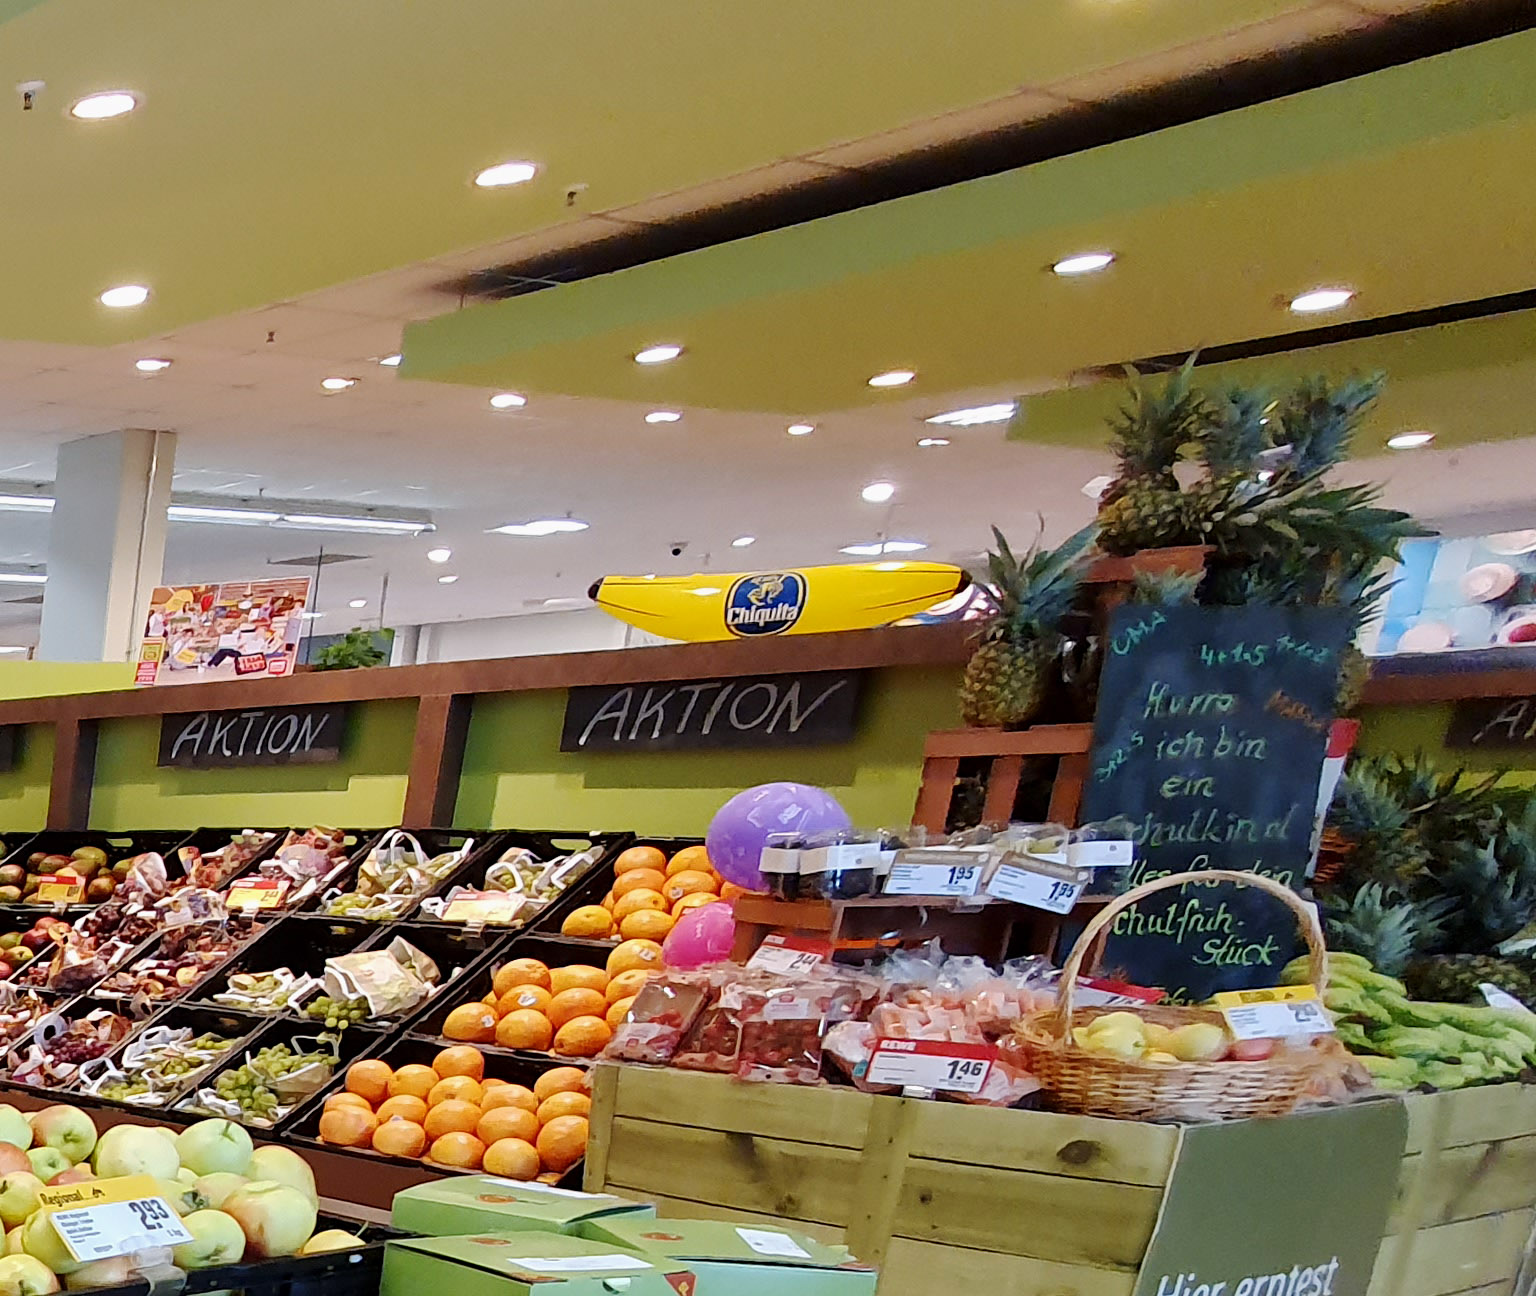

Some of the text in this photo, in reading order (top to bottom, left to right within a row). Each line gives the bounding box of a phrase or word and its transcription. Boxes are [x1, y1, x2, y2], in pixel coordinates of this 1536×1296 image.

[726, 604, 800, 627] Chiquita
[579, 680, 848, 746] AKTION
[171, 711, 329, 759] AKTION
[1213, 725, 1267, 759] bin
[1160, 772, 1215, 799] ein
